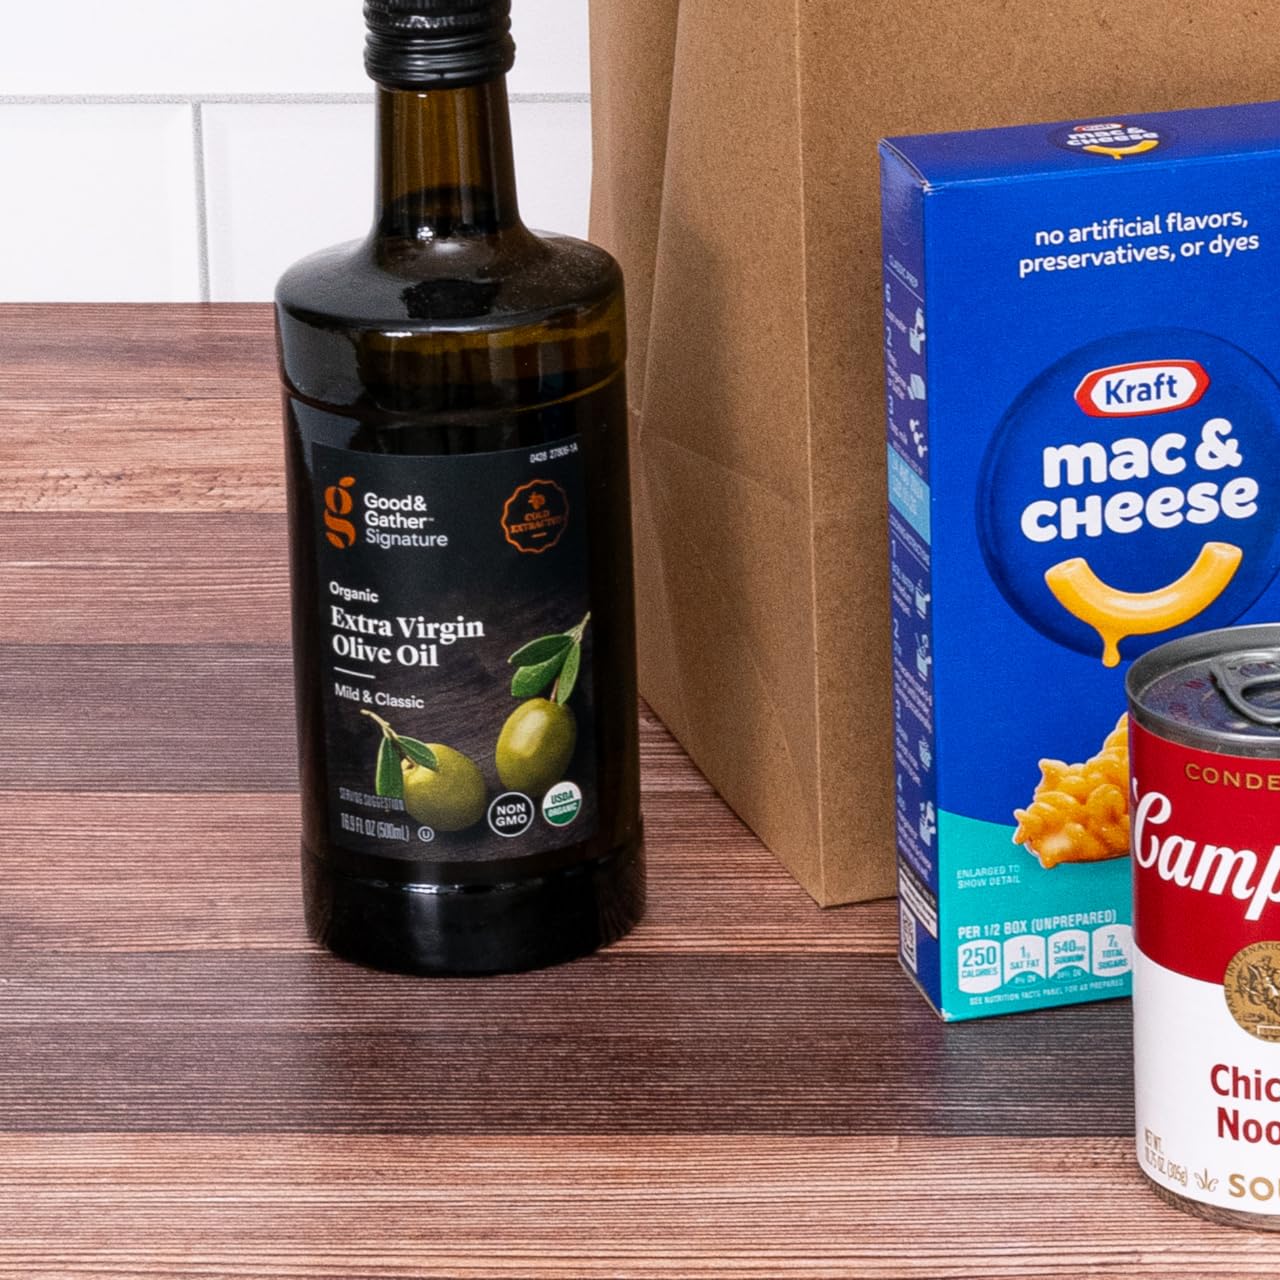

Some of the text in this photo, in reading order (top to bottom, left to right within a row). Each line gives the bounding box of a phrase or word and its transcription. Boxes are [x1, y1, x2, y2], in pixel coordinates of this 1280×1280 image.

[1035, 210, 1249, 247] no artificial flavors,
[1019, 232, 1260, 278] preservatives, or dyes
[1104, 372, 1178, 406] Kraft
[1042, 418, 1243, 489] mac &
[364, 492, 428, 511] Good&
[366, 528, 449, 549] Signature
[329, 581, 379, 603] Organic
[330, 605, 486, 645] Extra Virgin
[332, 634, 440, 667] Olive Oil
[334, 682, 424, 709] Mild & Classic
[551, 789, 574, 804] USDA
[495, 814, 527, 827] GMO
[496, 803, 526, 816] NON
[956, 864, 1021, 879] ENLARGED TO
[957, 875, 1021, 889] SHOW DETAIL
[957, 909, 1117, 939] PER 1/2 BOX (UNPREPARED)
[962, 945, 997, 967] 250
[1026, 959, 1040, 968] FAT
